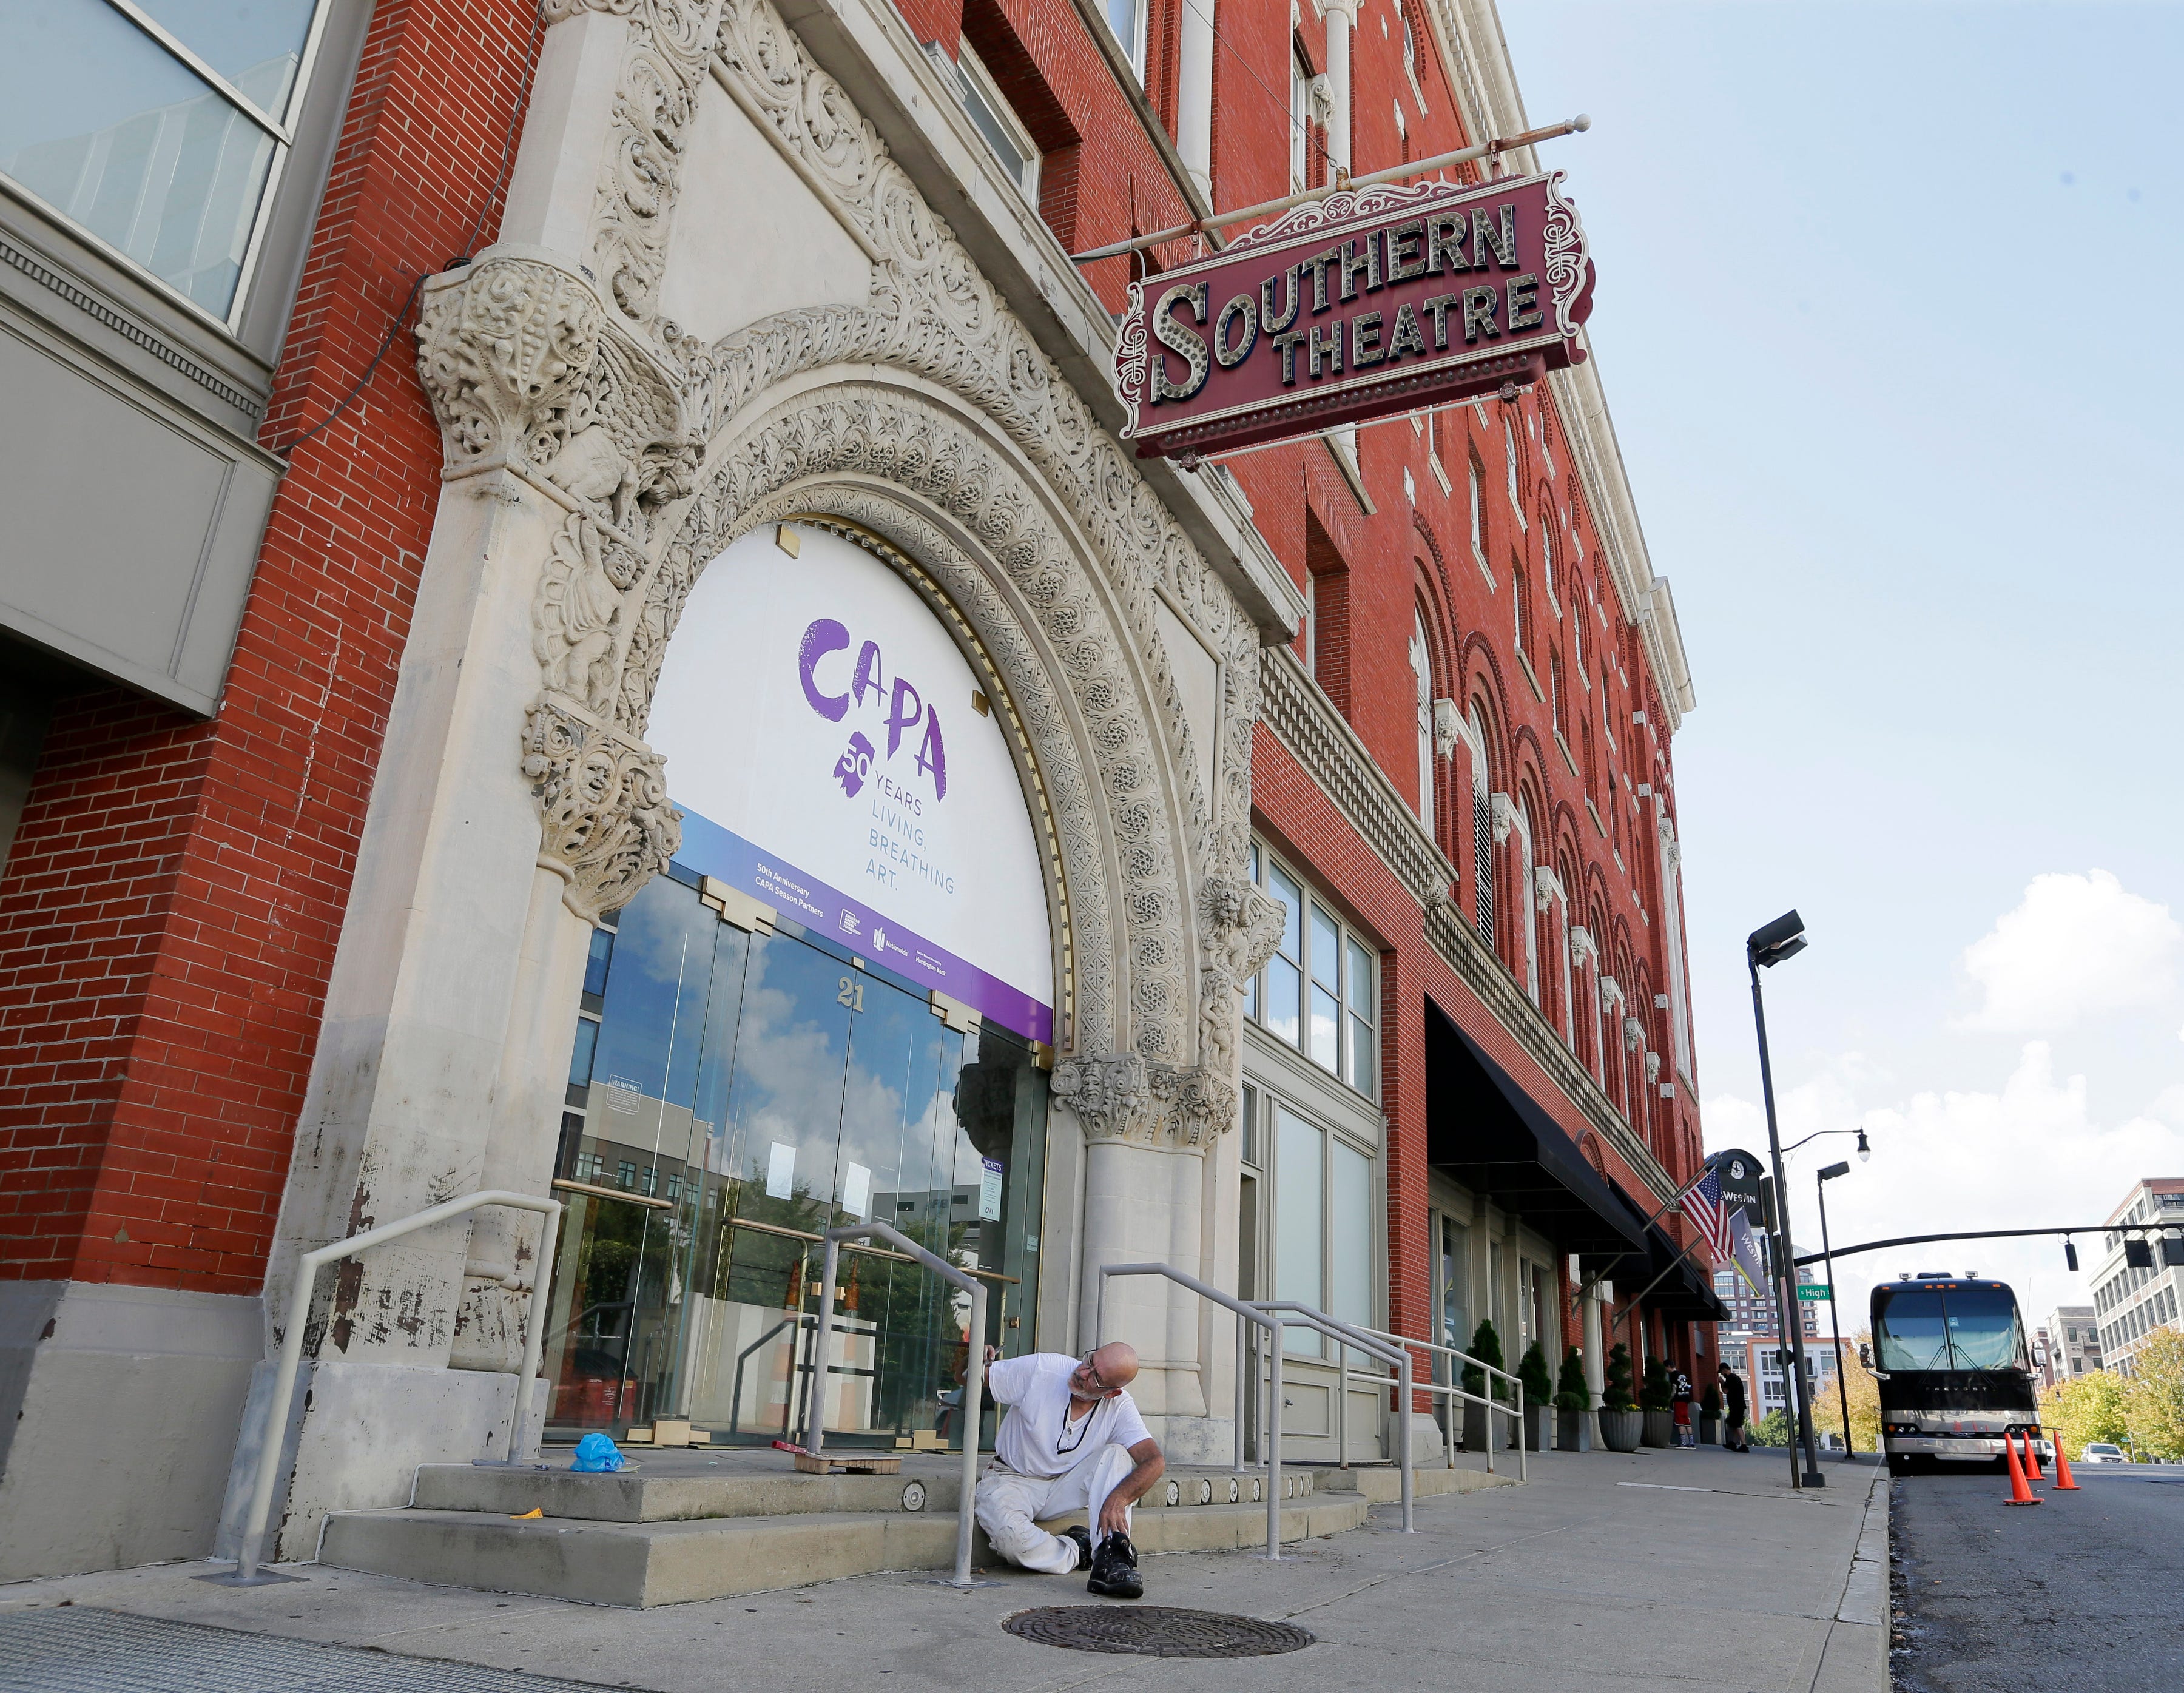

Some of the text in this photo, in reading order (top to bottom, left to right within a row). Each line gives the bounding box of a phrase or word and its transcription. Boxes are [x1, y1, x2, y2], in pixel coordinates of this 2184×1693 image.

[1150, 203, 1520, 406] SOUTHERN
[1272, 272, 1545, 387] THEATRE
[798, 618, 948, 803] CAPA
[841, 744, 872, 784] 50
[875, 770, 922, 816] YEARS
[871, 799, 927, 852] LIVING,
[757, 863, 810, 899] 50th Anniversary
[865, 858, 899, 891] ART.
[869, 827, 955, 895] BREATHING
[755, 877, 824, 918] CAPA Season Partners
[915, 956, 937, 971] Huntington
[936, 967, 946, 977] Bank
[837, 977, 864, 1014] 21
[612, 1079, 639, 1092] WARNING!
[983, 1159, 1002, 1171] TICKETS
[1805, 1288, 1826, 1299] High
